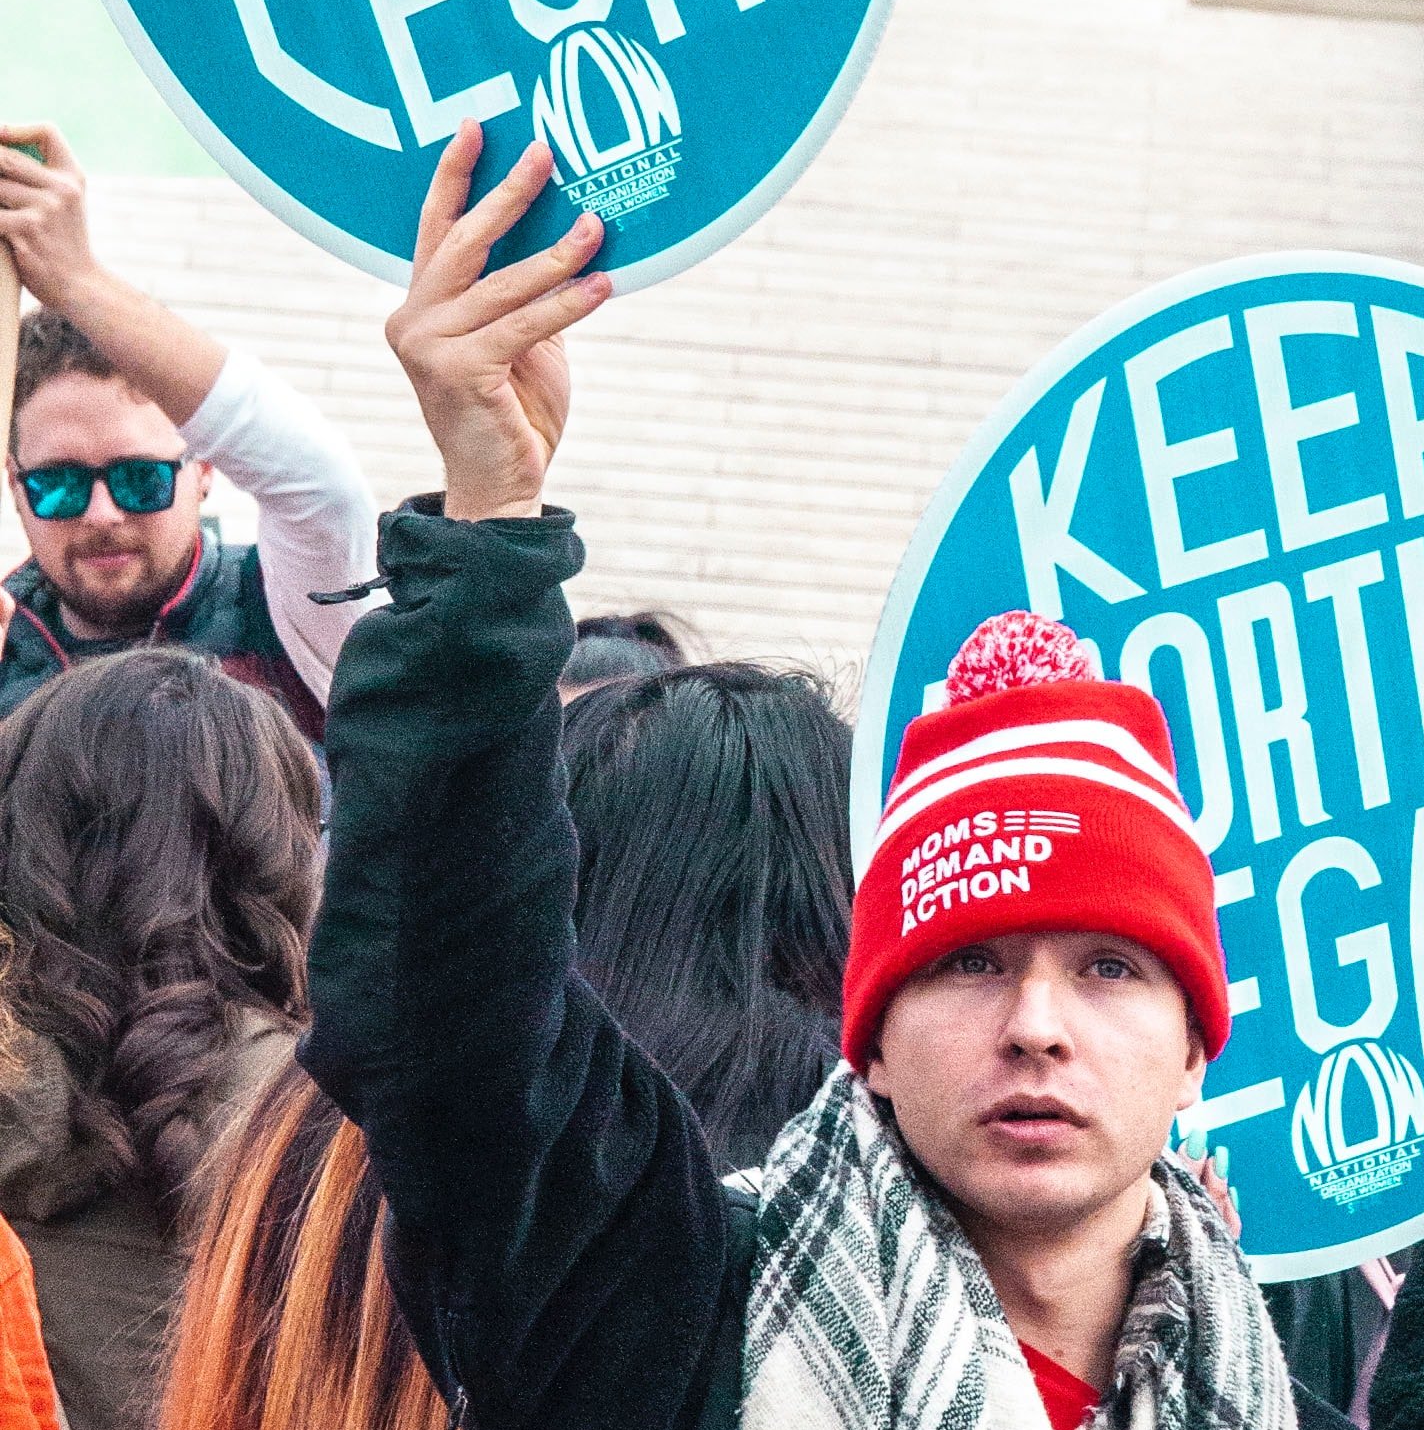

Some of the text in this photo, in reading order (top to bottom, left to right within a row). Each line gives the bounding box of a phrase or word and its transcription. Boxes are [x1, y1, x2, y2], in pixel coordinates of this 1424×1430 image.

[533, 27, 682, 185] NOW
[567, 147, 681, 201] NATIONAL
[582, 166, 675, 212] ORGANIZATION
[600, 184, 668, 219] FOR WOMEN
[902, 811, 997, 878] MOMS
[901, 835, 1052, 907] DEMAND
[901, 866, 1030, 937] ACTION
[1310, 1143, 1420, 1187] NATIONAL
[1321, 1160, 1412, 1197] ORGANIZATION
[1335, 1175, 1402, 1202] FOR WOMEN
